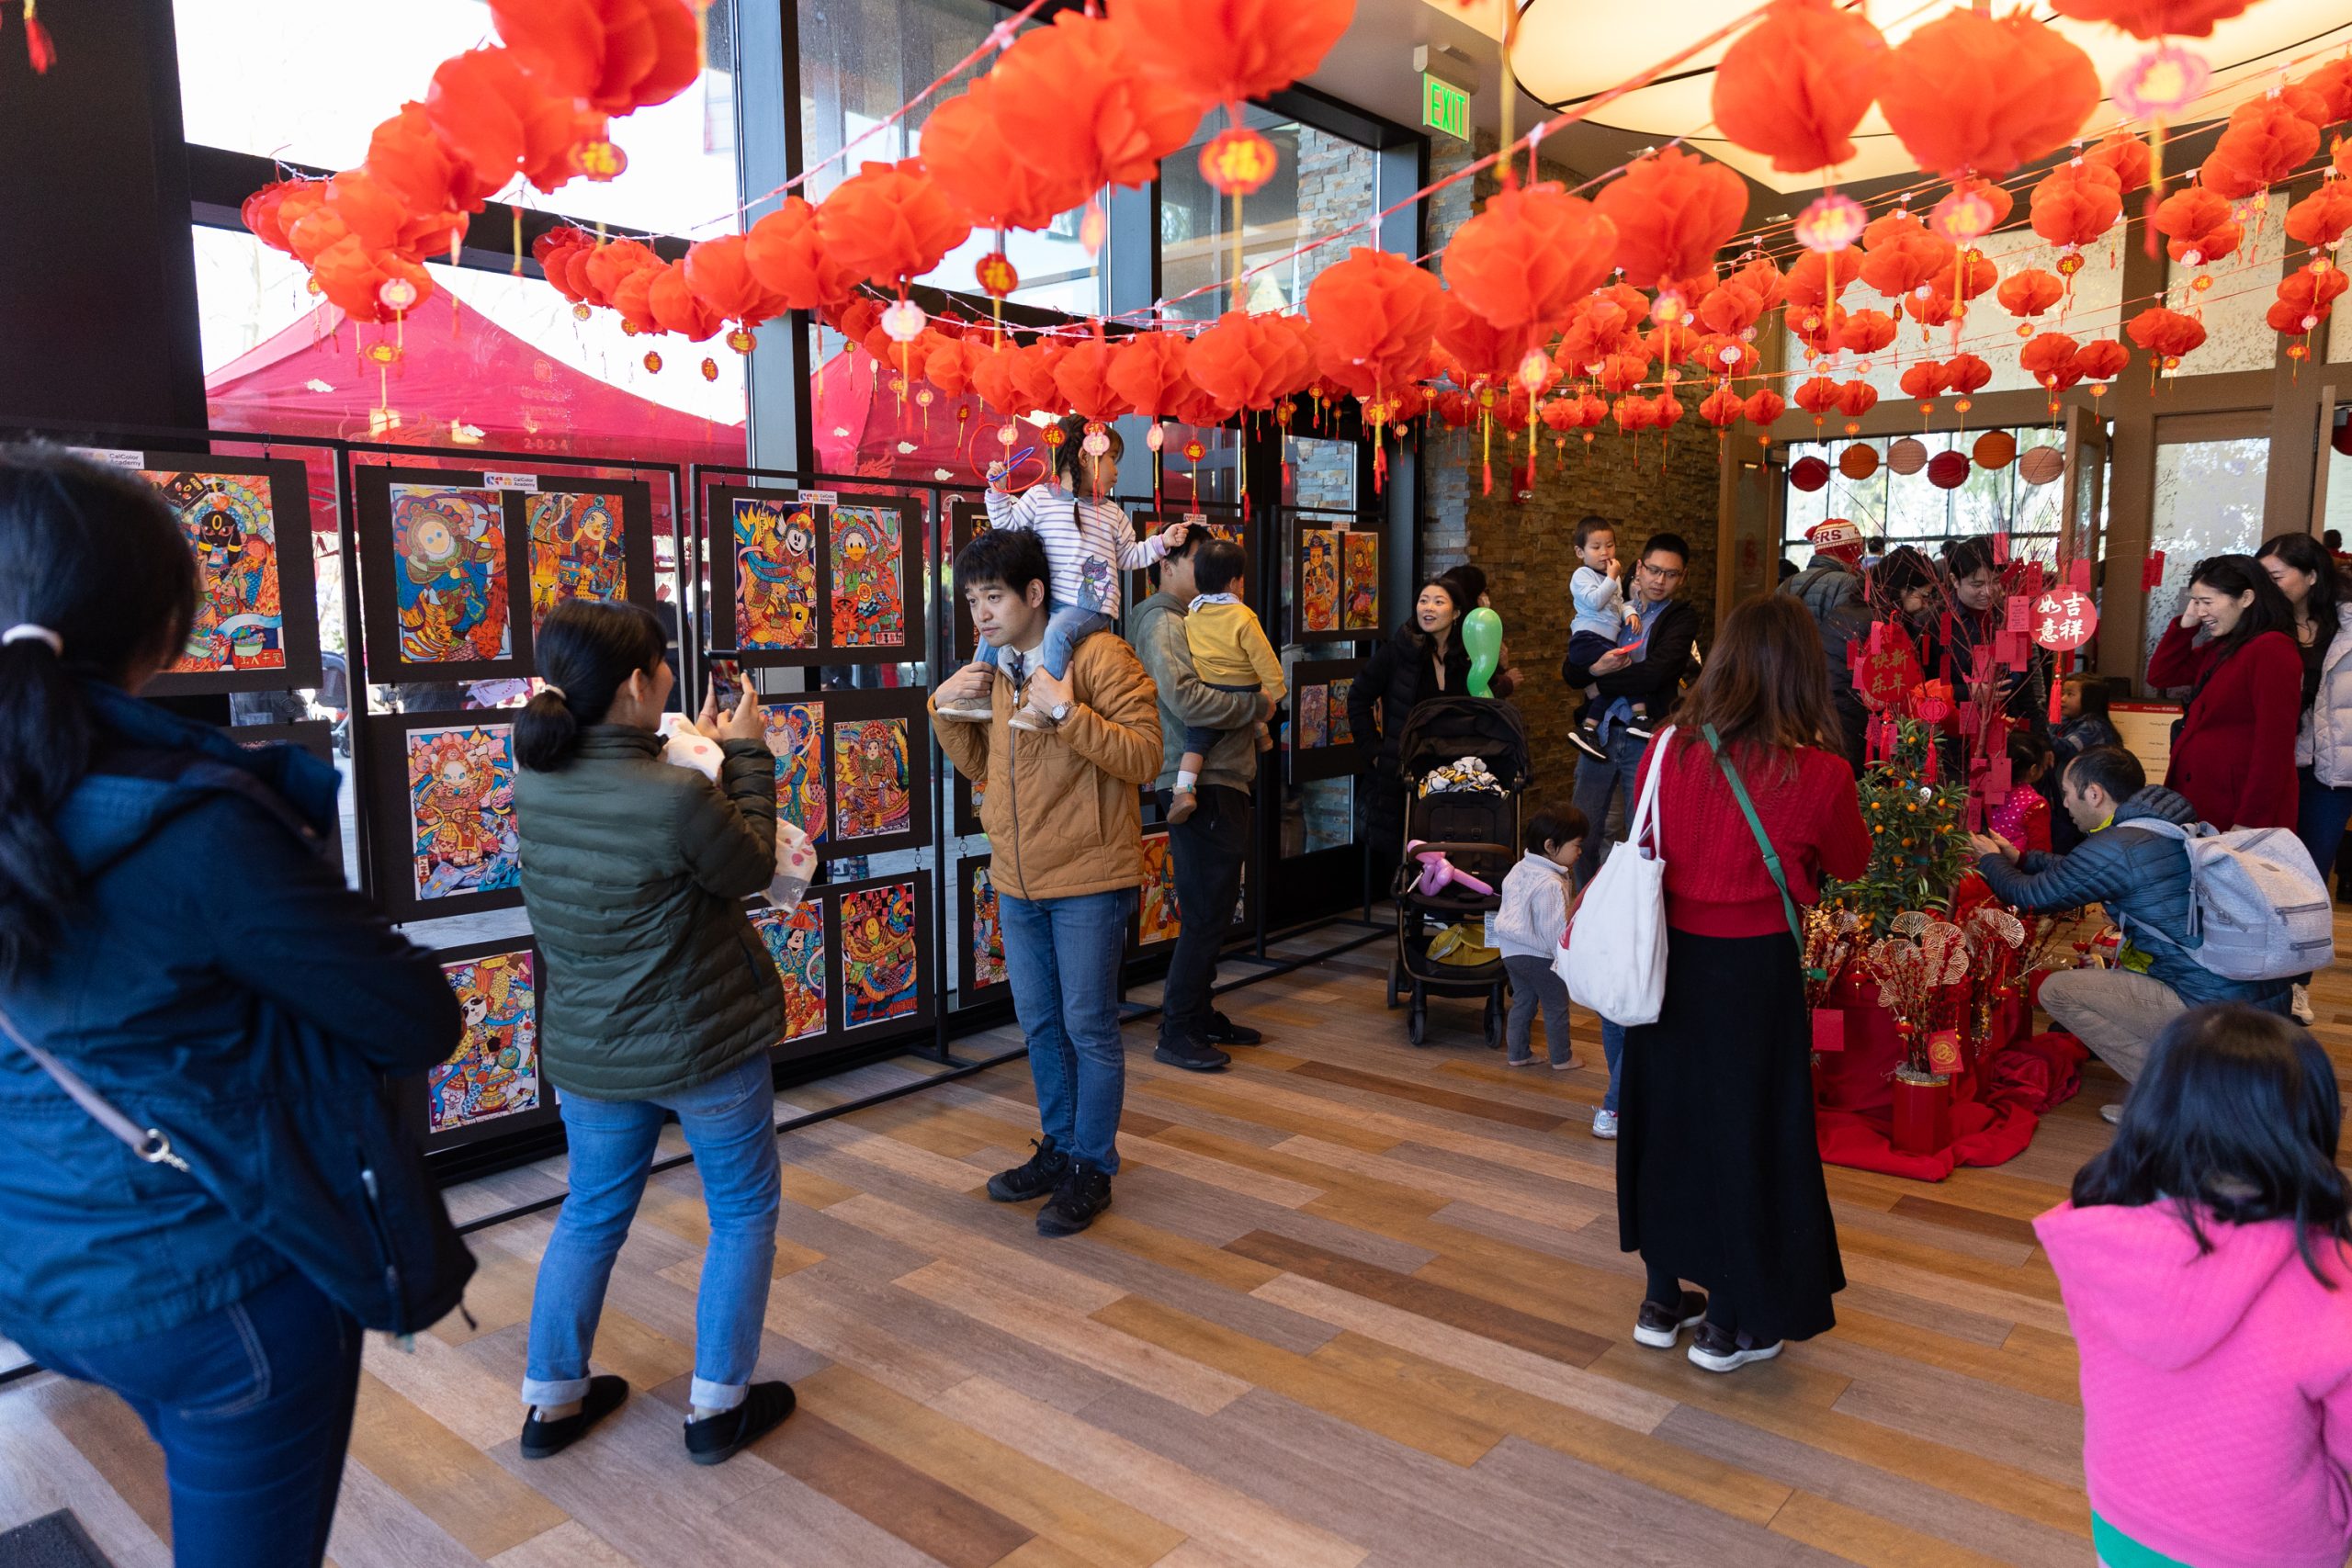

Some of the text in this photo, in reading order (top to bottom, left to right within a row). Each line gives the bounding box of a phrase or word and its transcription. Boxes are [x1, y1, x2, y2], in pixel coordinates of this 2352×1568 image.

[1430, 82, 1465, 138] EXIT
[1217, 140, 1260, 182] 福
[1965, 250, 1979, 263] 福
[2061, 259, 2075, 273] 福
[984, 261, 1010, 290] 福
[1368, 403, 1386, 422] 福
[523, 437, 569, 450] 2024
[1046, 430, 1060, 444] 福
[1089, 437, 1104, 450] 福
